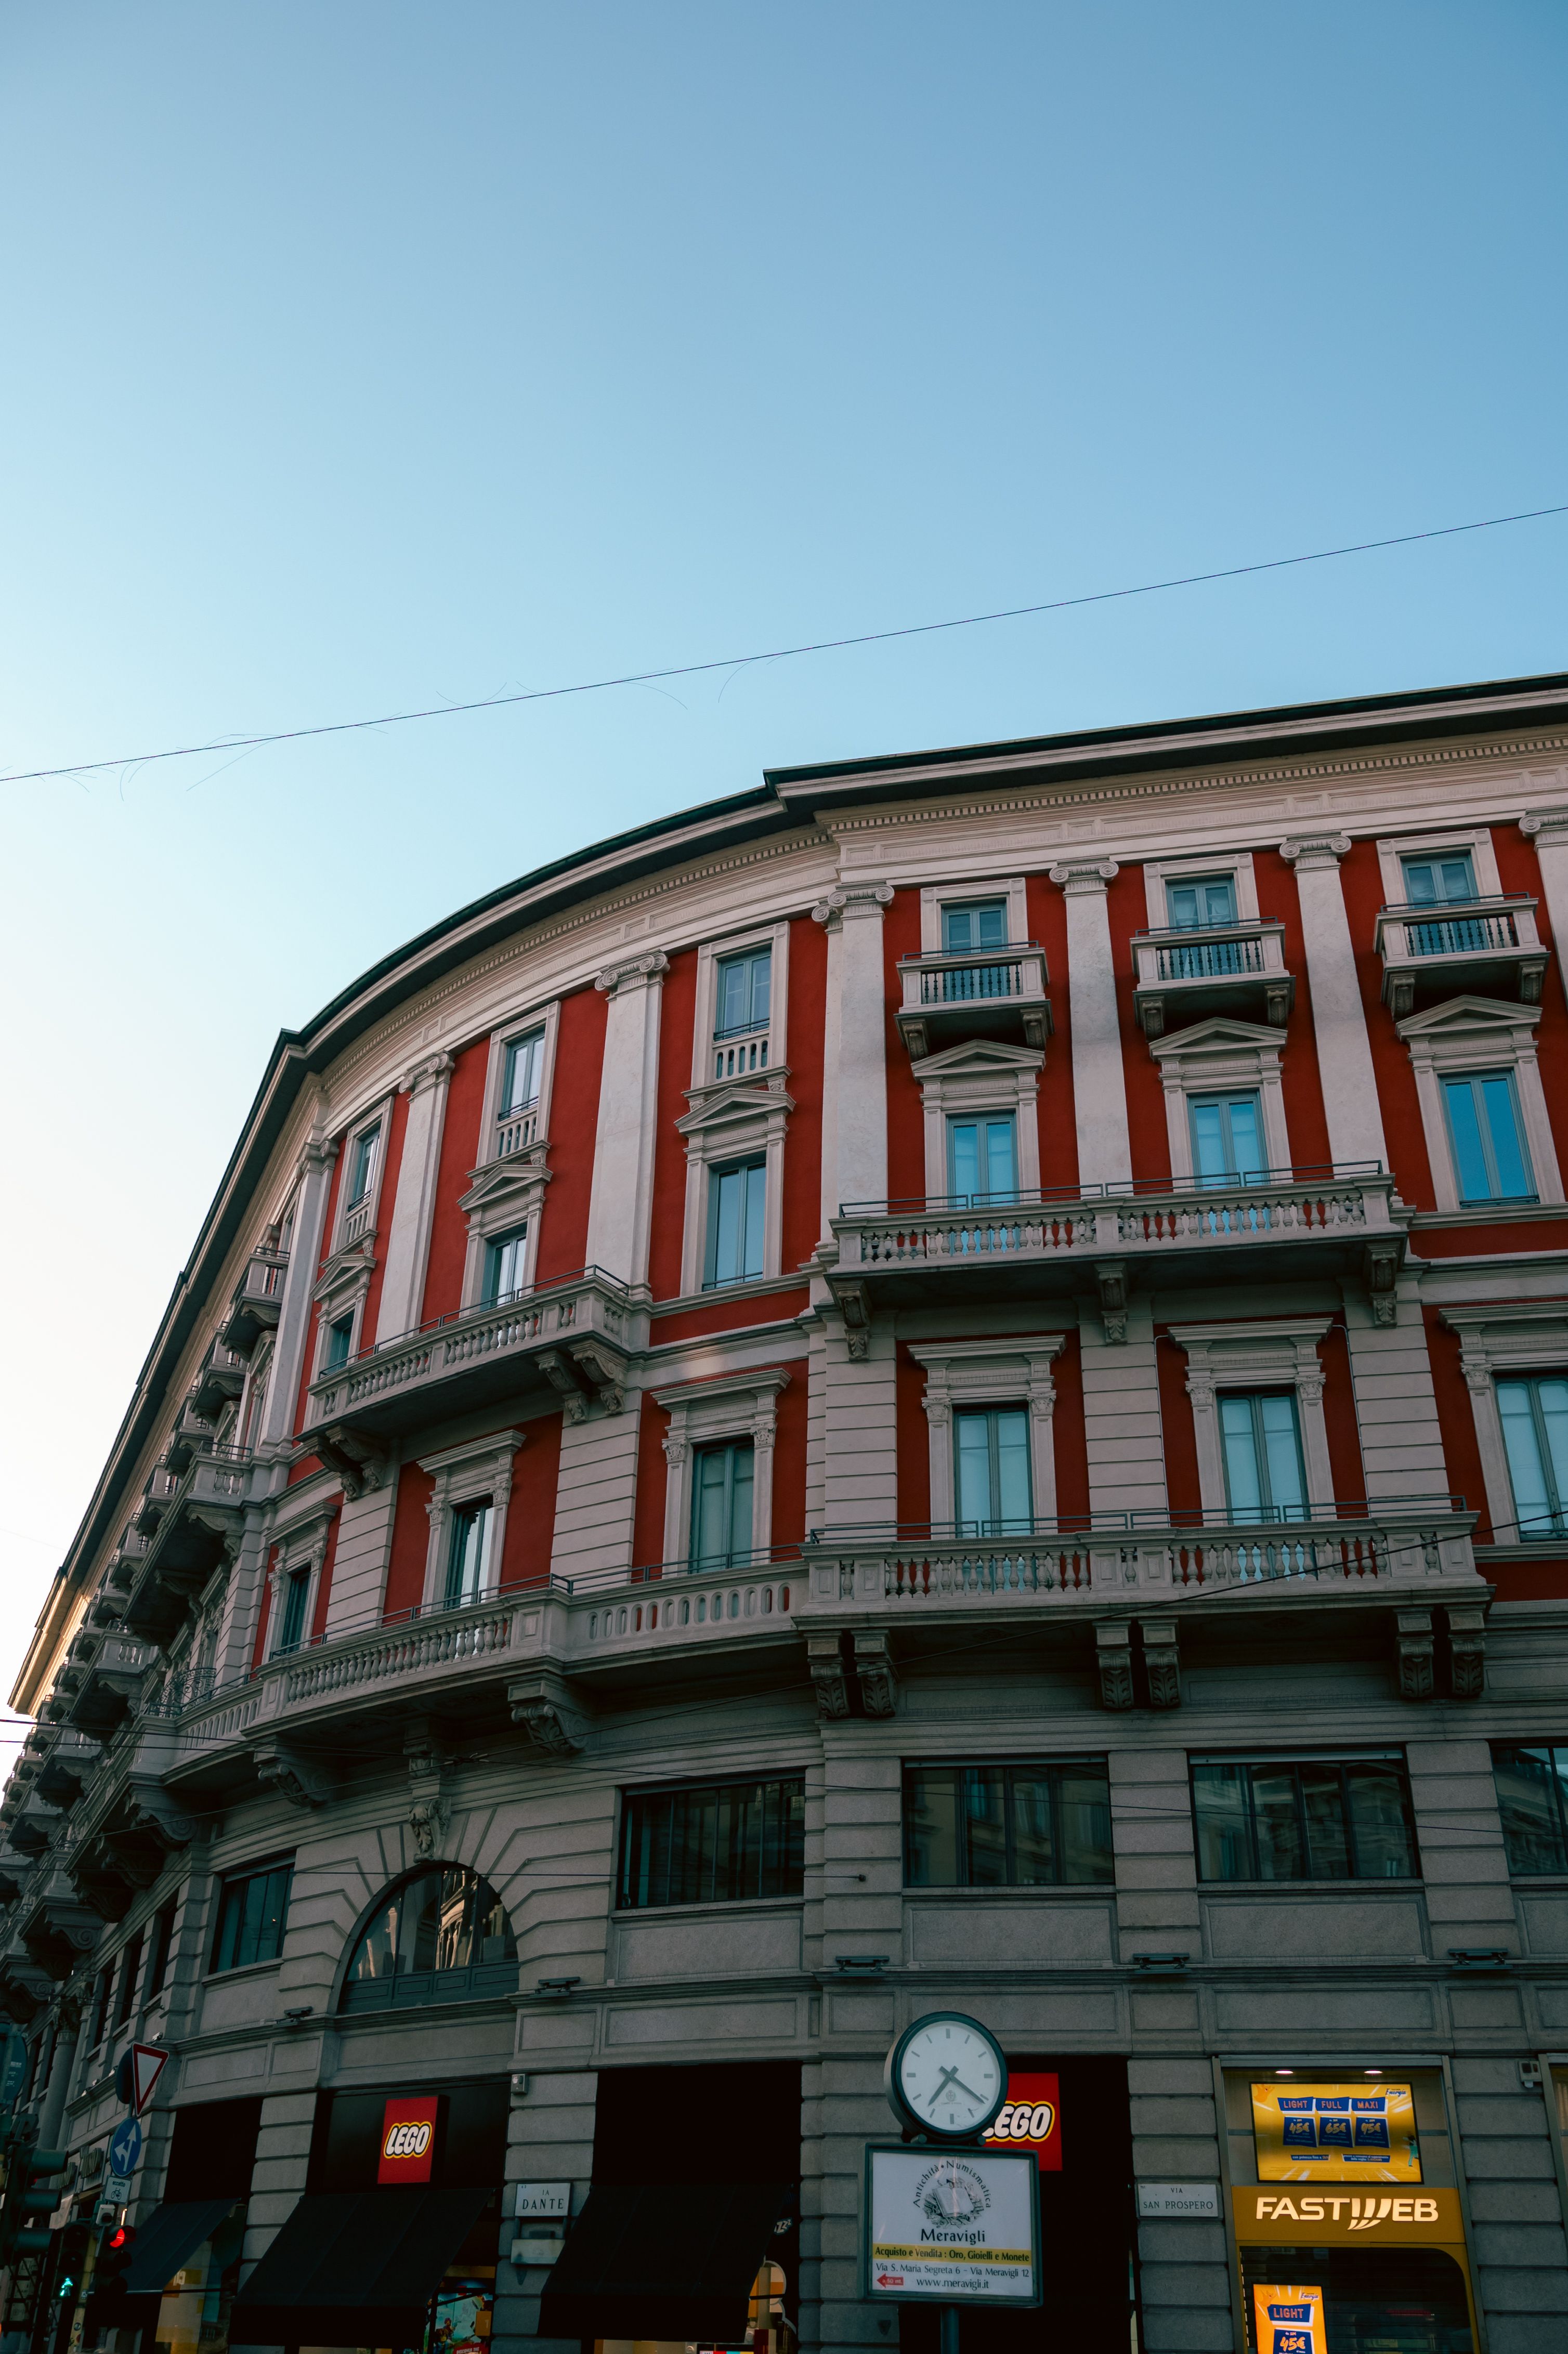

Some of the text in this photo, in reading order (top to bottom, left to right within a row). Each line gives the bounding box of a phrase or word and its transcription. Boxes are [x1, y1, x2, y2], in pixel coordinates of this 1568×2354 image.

[1283, 2100, 1308, 2109] LIGHT
[1322, 2101, 1342, 2109] FULL
[982, 2104, 1051, 2138] EGO
[1289, 2122, 1310, 2134] 45€
[1325, 2122, 1347, 2134] 65€
[385, 2123, 431, 2156] LEGO
[913, 2160, 991, 2208] Antichità Numismatica
[522, 2199, 564, 2209] DANTE
[1165, 2201, 1213, 2209] PROSPERO
[1256, 2197, 1439, 2230] FASTWEB
[920, 2228, 985, 2245] Meravigli
[875, 2247, 907, 2258] Acquisto
[914, 2248, 942, 2258] Vendita
[949, 2250, 966, 2261] Oro,
[968, 2251, 992, 2260] Gioielli
[1001, 2253, 1029, 2261] Monete
[876, 2263, 888, 2271] Via
[891, 2264, 898, 2272] S.
[900, 2264, 921, 2272] Maria
[924, 2265, 952, 2275] Segreta
[970, 2267, 982, 2275] Via
[985, 2268, 1018, 2279] Meravigli
[916, 2279, 989, 2291] www.meravigli.it
[1273, 2308, 1304, 2319] LIGHT
[1279, 2336, 1306, 2351] 45€
